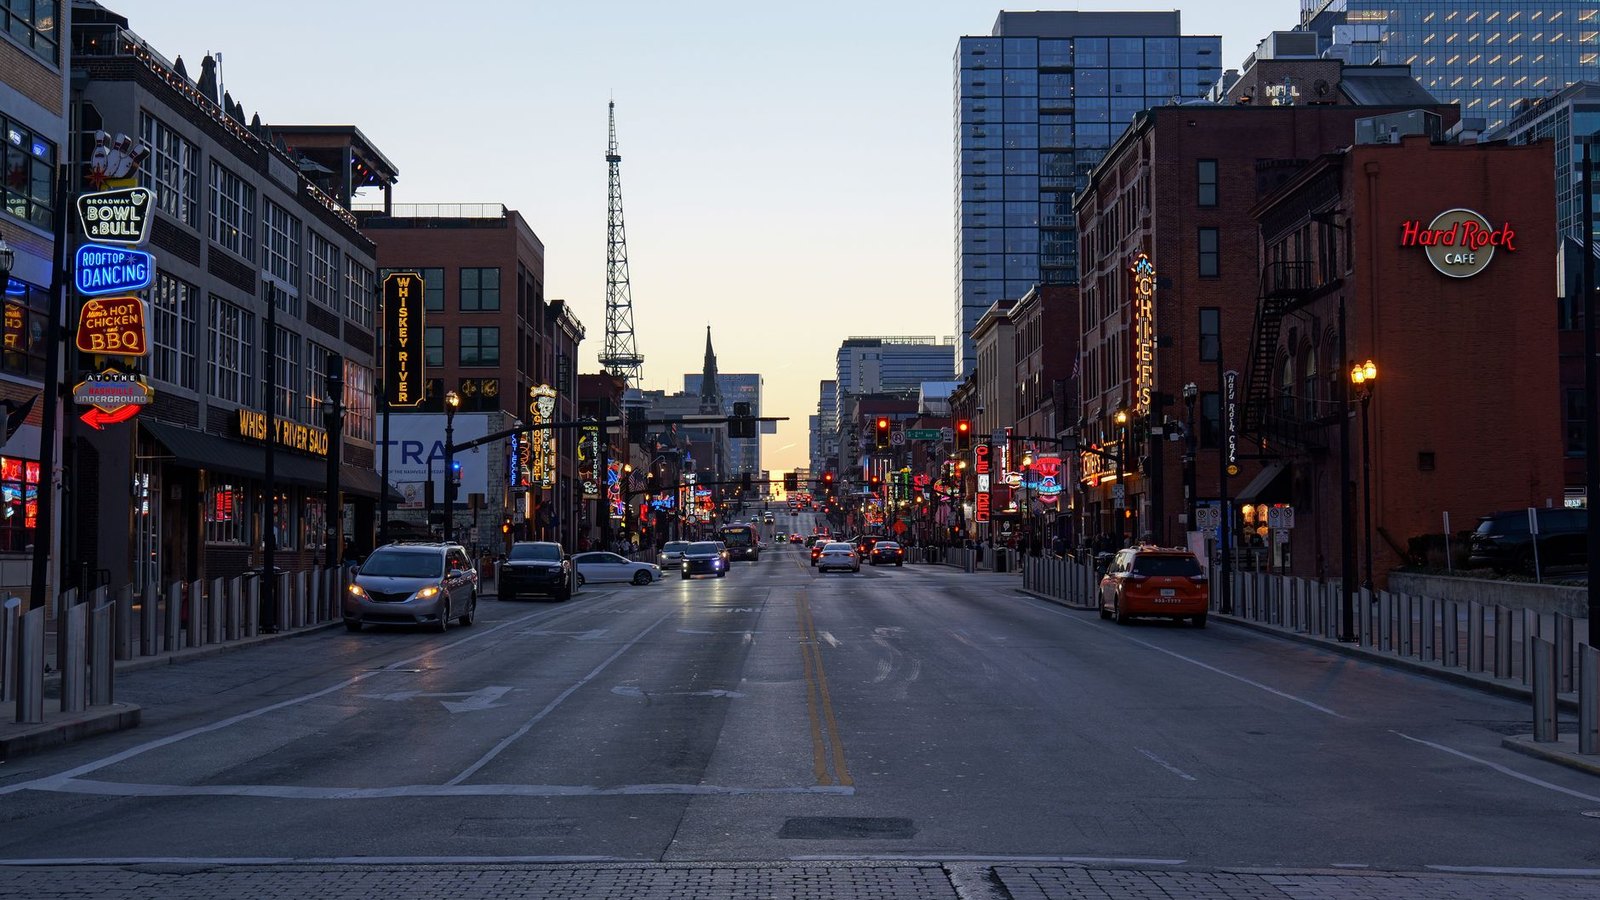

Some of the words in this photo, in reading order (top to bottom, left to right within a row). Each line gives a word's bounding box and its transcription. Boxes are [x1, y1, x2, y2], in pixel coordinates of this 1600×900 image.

[87, 206, 141, 221] BOWL
[99, 221, 140, 235] BULL
[1402, 220, 1458, 247] Hard
[1461, 220, 1517, 251] Rock
[82, 252, 125, 266] ROOFTOP
[1444, 252, 1476, 265] CAFE
[82, 264, 146, 288] DANCING
[109, 304, 135, 316] HOT
[396, 277, 411, 348] WHISKEY
[86, 314, 138, 329] CHICKEN
[90, 330, 139, 351] BBQ
[1139, 278, 1152, 405] CHIEFS
[398, 351, 409, 403] RIVER
[75, 395, 148, 404] UNDERGROUND
[88, 387, 133, 395] NASHVILLE
[1227, 403, 1235, 432] Rock
[239, 408, 281, 443] WHISY
[283, 420, 308, 452] RIVER
[309, 428, 329, 456] SALO
[1228, 435, 1236, 463] Cafe
